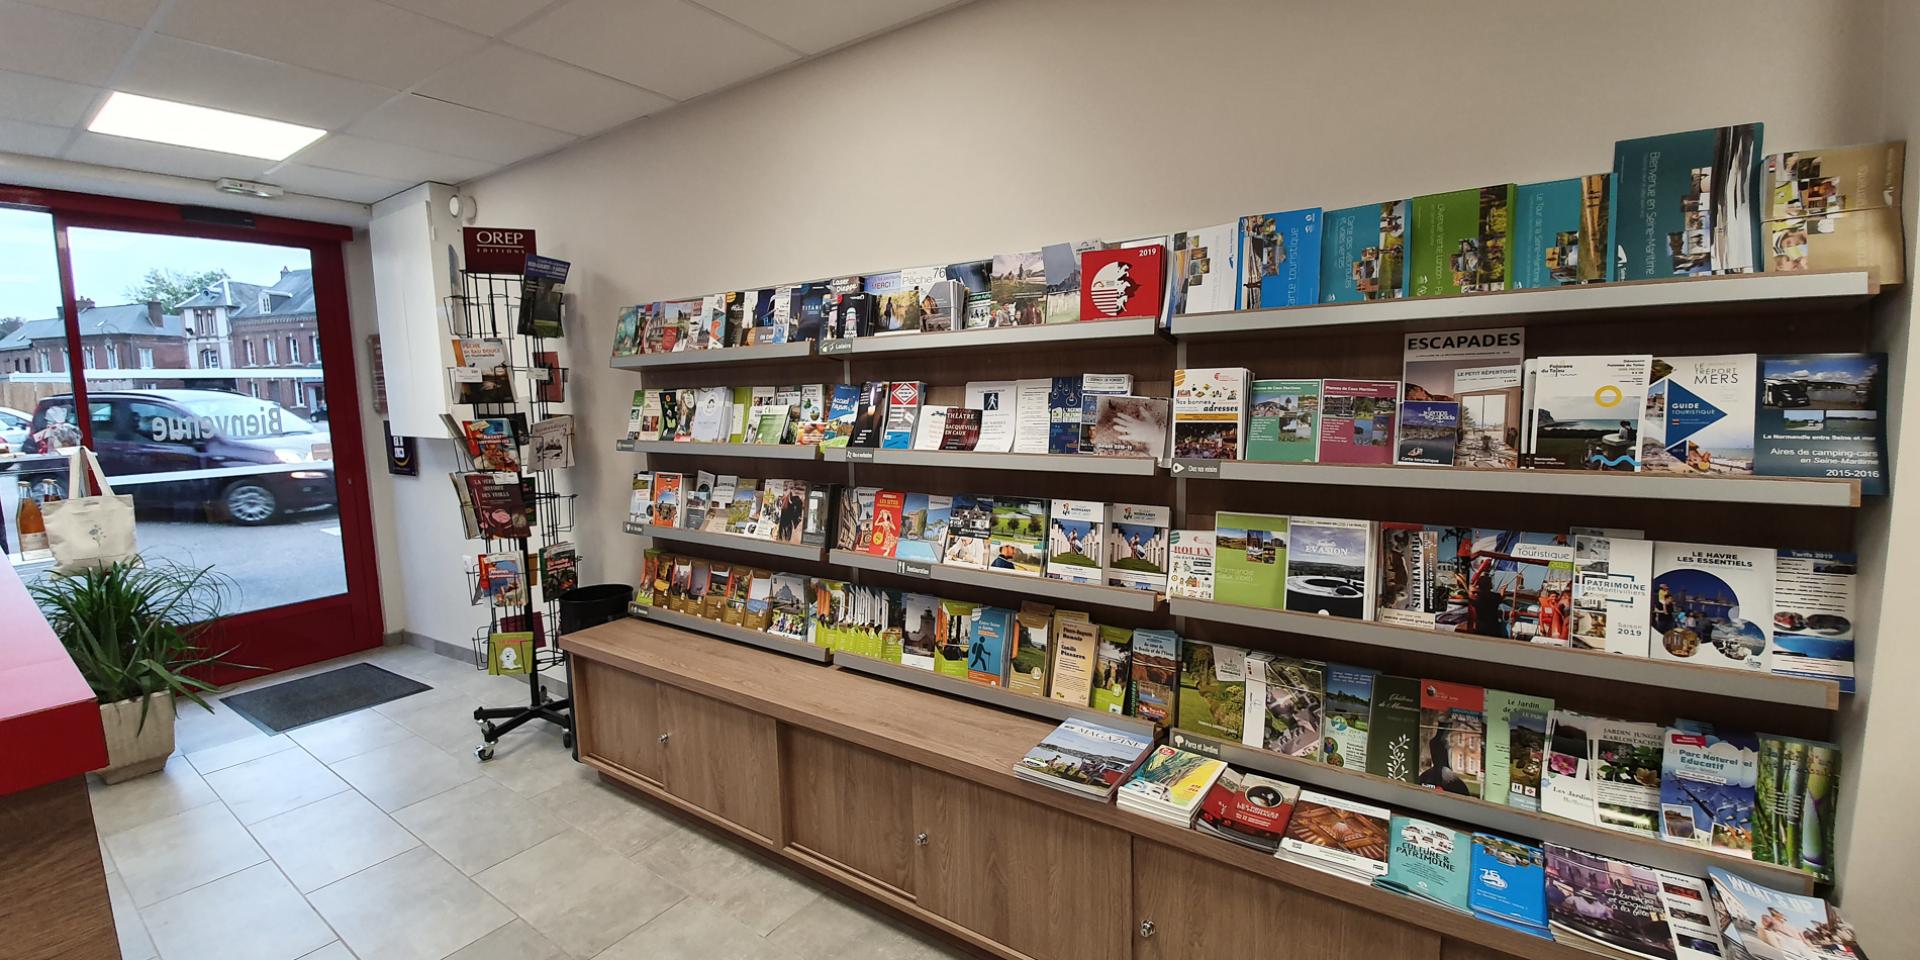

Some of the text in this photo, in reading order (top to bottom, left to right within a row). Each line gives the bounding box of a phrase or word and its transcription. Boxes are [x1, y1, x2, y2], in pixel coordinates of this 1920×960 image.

[1645, 151, 1661, 275] Bienvenue en Seine-Maritime
[1345, 215, 1356, 235] Carte
[476, 231, 524, 245] OREP
[1138, 247, 1157, 257] 2019
[1285, 227, 1300, 281] touristique
[933, 267, 946, 279] 76
[902, 275, 933, 286] Pêche
[1407, 332, 1521, 351] ESCAPADES
[1694, 373, 1739, 385] MERS
[1187, 398, 1211, 406] bonnes
[1203, 404, 1239, 412] adresses
[1770, 448, 1795, 456] Aires
[1811, 449, 1878, 458] camping-cars
[1813, 457, 1880, 465] Seine-Maritime
[1825, 469, 1880, 478] 2015-2016
[1517, 548, 1570, 560] Touristique
[1706, 552, 1738, 560] HAVRE
[1697, 557, 1753, 568] ESSENTIELS
[1586, 578, 1646, 591] PATRIMOINE
[1617, 621, 1642, 629] Saison
[1617, 628, 1642, 637] 2019
[1507, 698, 1540, 709] Le Jardin
[1077, 727, 1147, 749] MAGAZINE
[1603, 727, 1631, 737] JARDIN
[1633, 731, 1662, 740] JUNGLE
[1679, 749, 1701, 759] Parc
[1703, 753, 1739, 766] Naturel
[1679, 756, 1725, 771] Educatif
[1553, 786, 1566, 794] Les
[1402, 842, 1450, 863] CULTURE &
[1395, 847, 1456, 873] PATRIMOINE
[1725, 873, 1791, 909] WHAT'S
